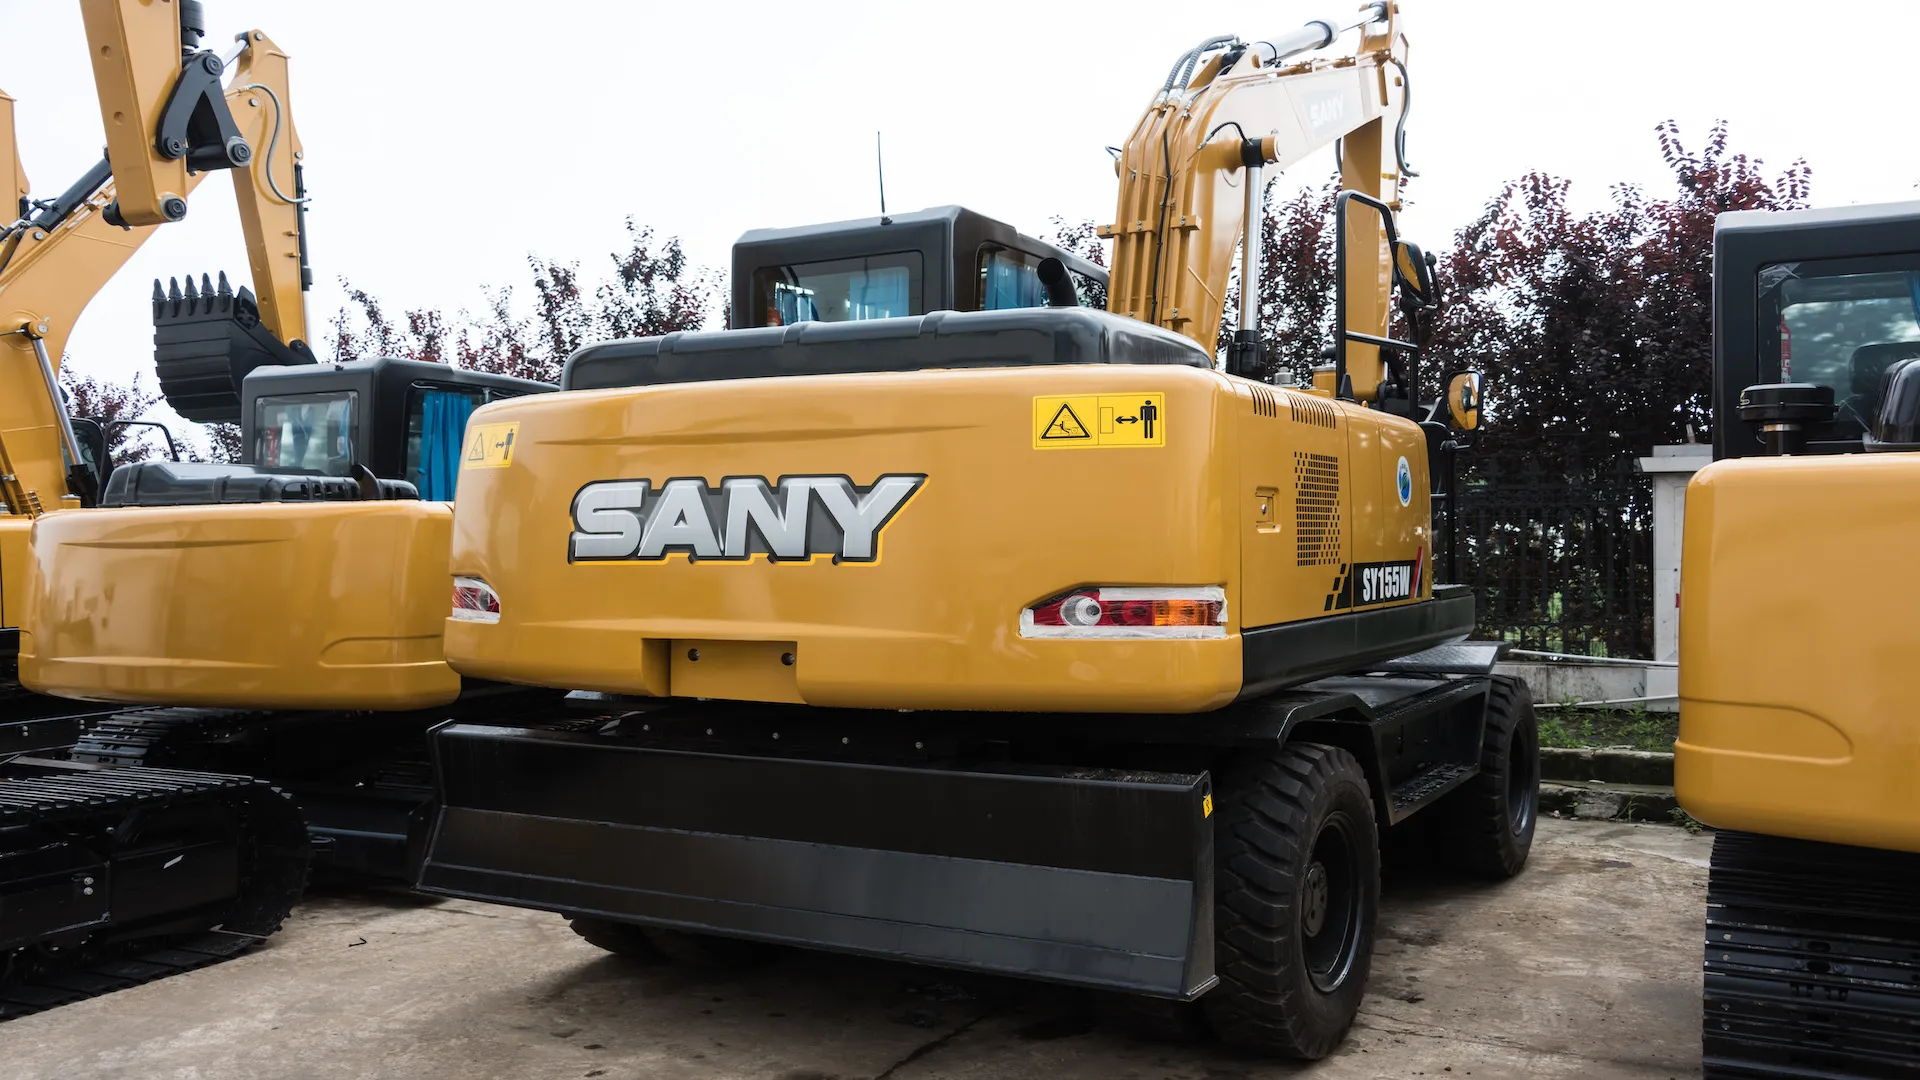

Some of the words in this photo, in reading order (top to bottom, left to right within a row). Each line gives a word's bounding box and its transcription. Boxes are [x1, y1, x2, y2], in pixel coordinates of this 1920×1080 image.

[1310, 93, 1344, 129] SANY
[570, 474, 926, 562] SANY
[1362, 565, 1411, 602] SY155W
